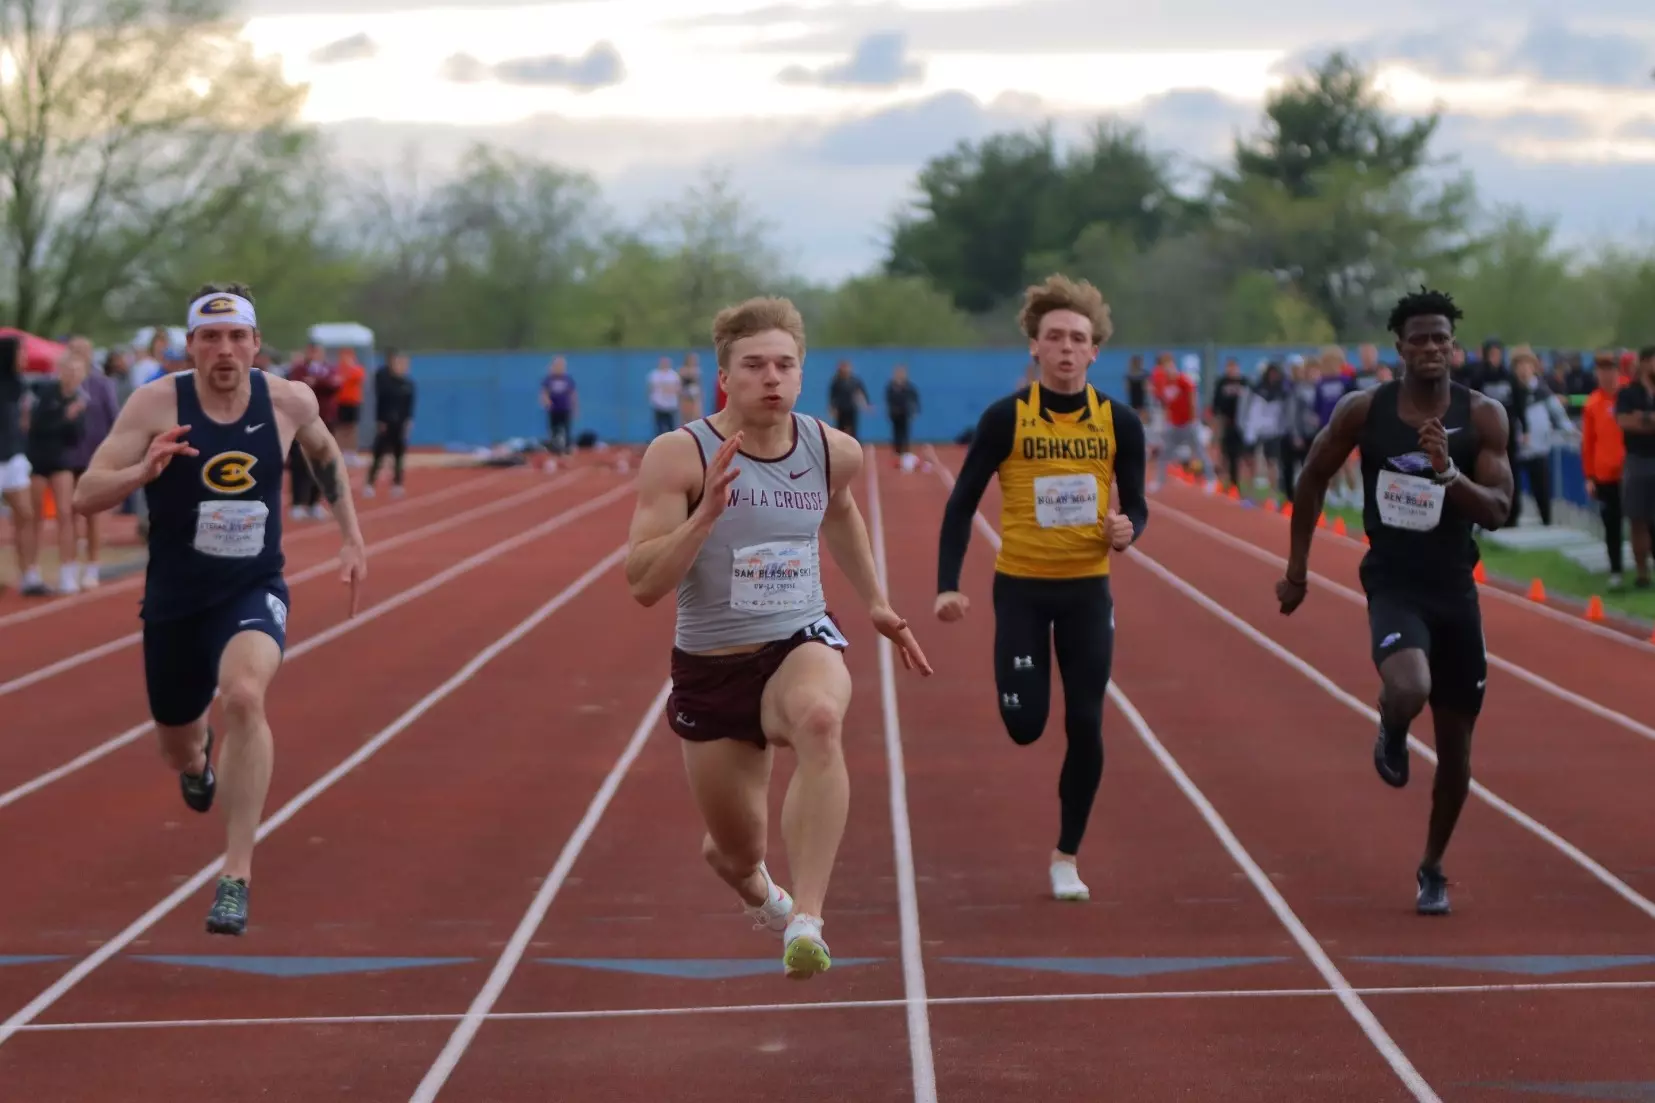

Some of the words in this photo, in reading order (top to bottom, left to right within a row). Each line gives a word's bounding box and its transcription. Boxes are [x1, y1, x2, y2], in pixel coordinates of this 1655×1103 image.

[1023, 437, 1109, 459] OSHKOSH
[774, 490, 823, 511] CROSSE
[734, 568, 754, 578] SAM
[758, 567, 811, 579] BLASKOWSKI
